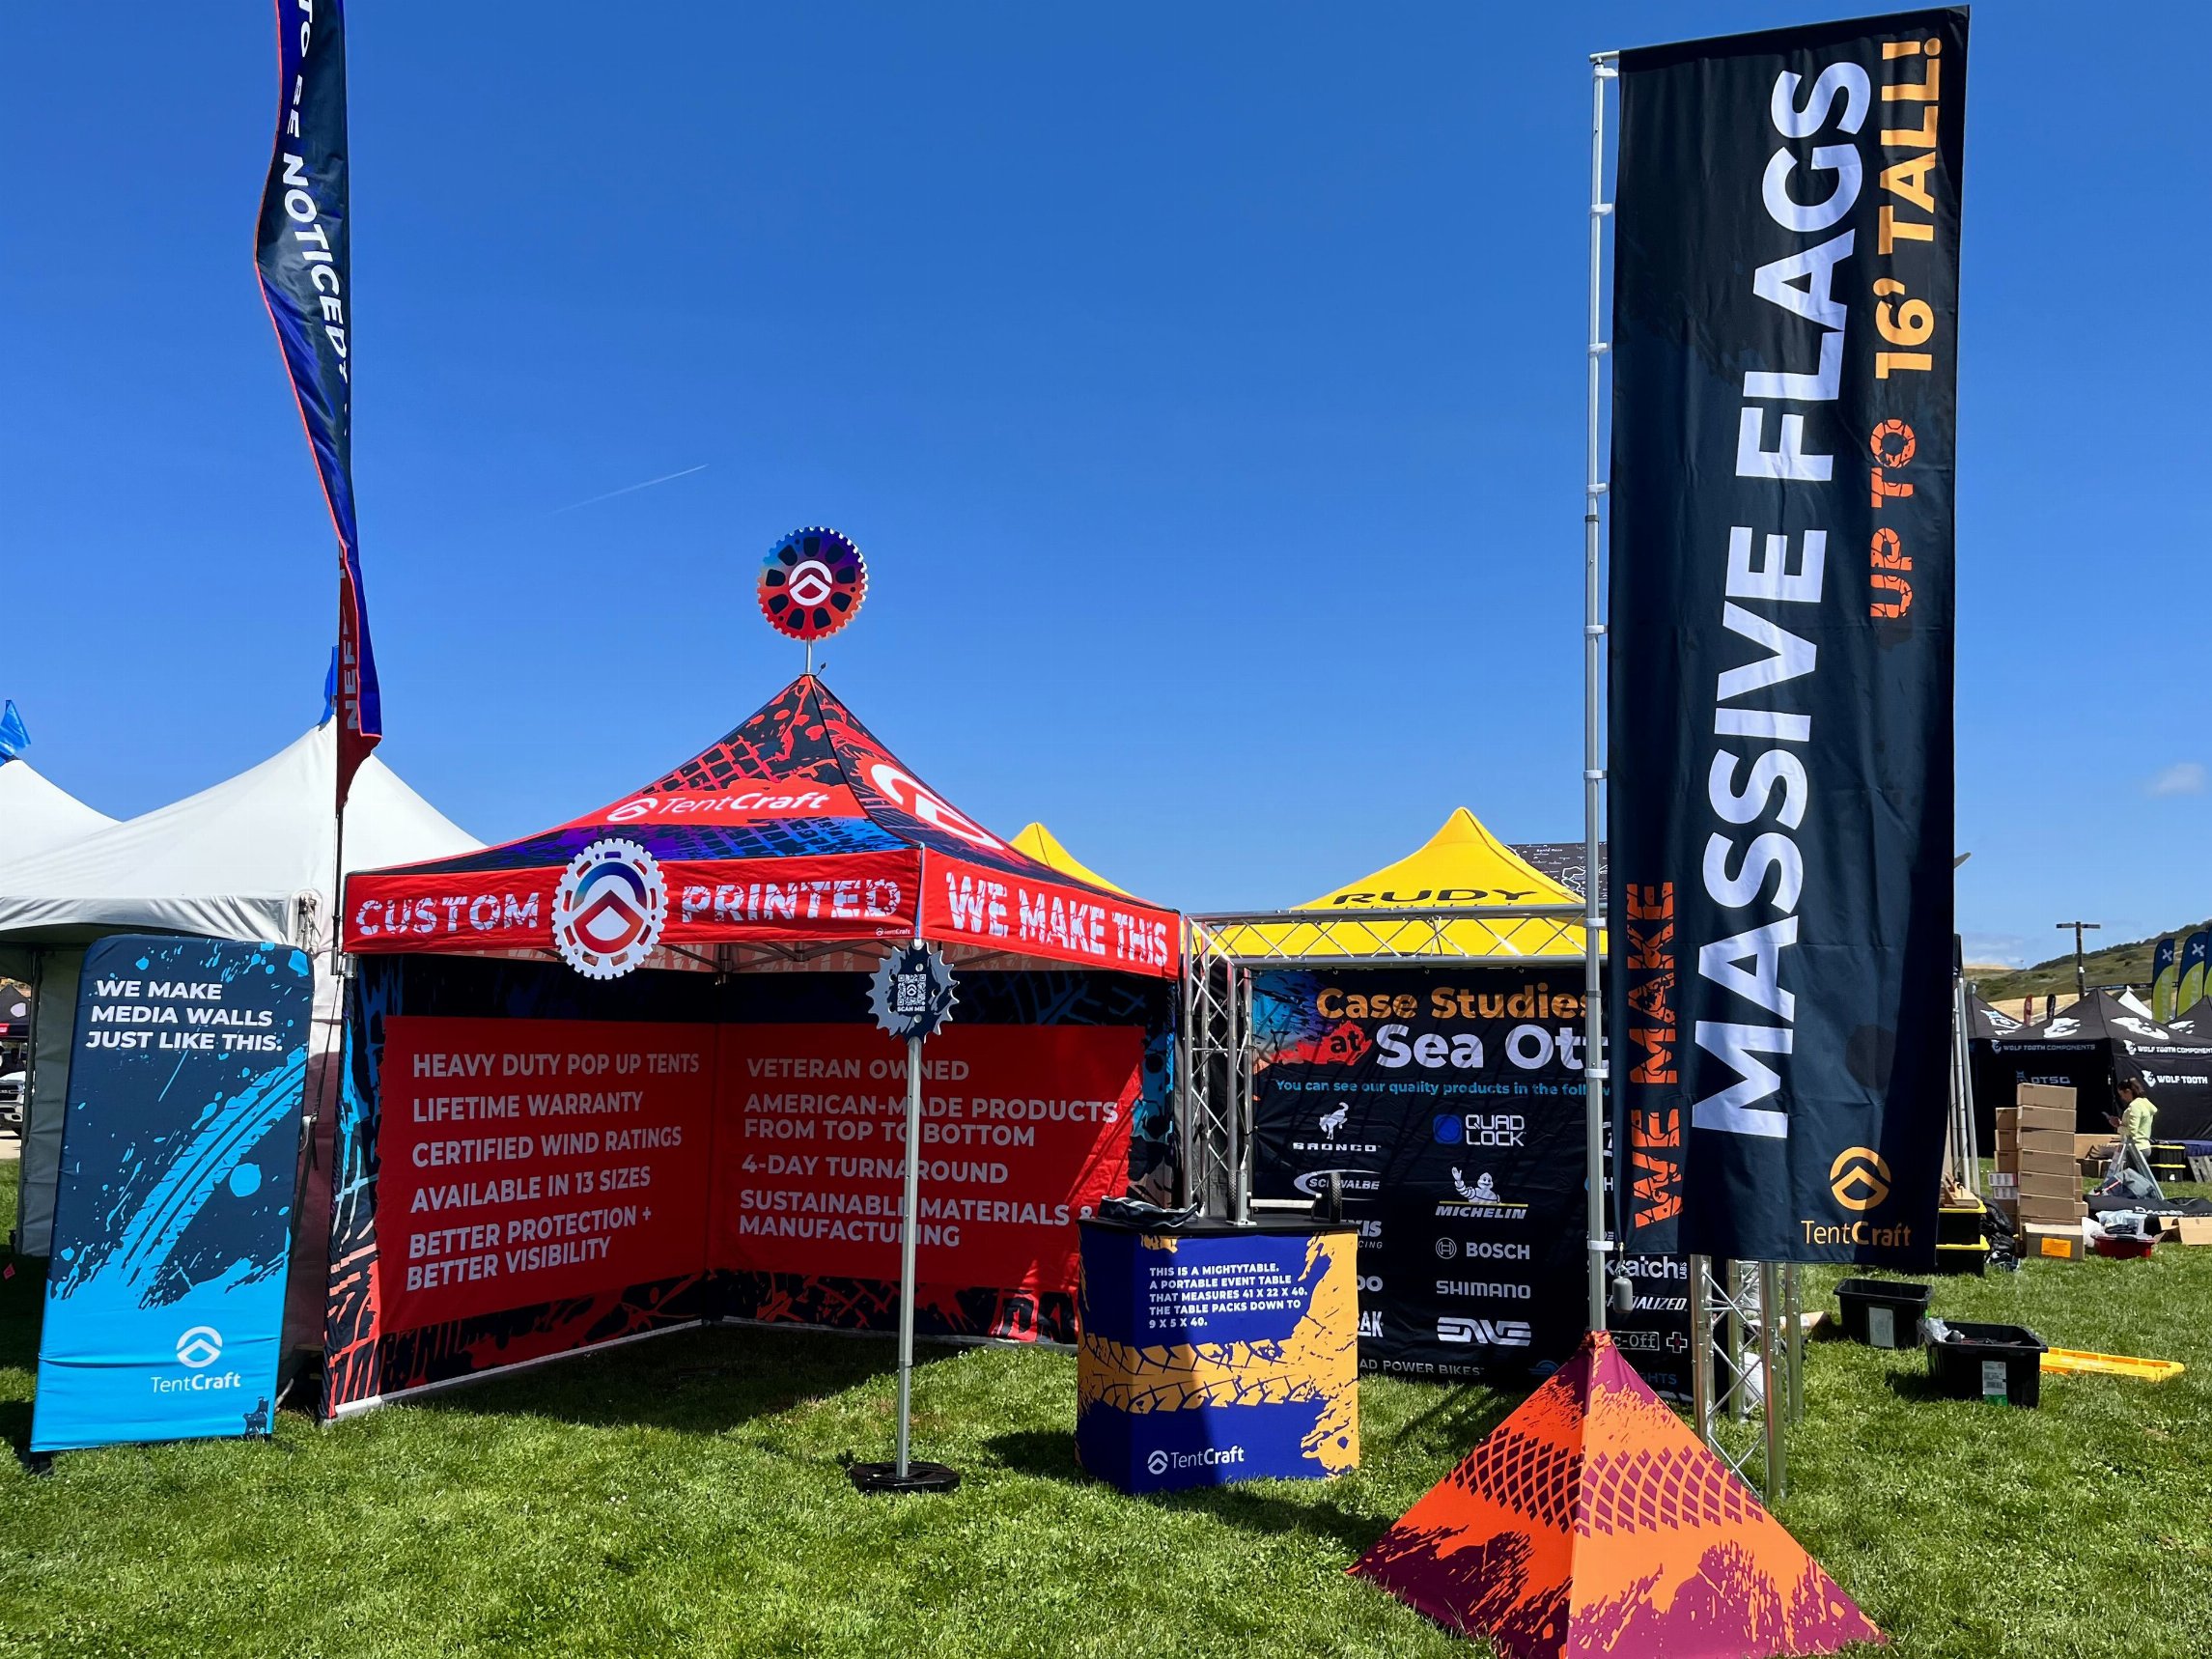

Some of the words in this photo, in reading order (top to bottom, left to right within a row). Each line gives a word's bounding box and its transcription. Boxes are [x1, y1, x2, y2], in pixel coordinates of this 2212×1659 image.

[287, 74, 303, 138] BE
[1878, 36, 1943, 255] TALL!
[1736, 60, 1872, 482] FLAGS
[1869, 418, 1916, 508] TO
[1869, 526, 1914, 619] UP
[658, 792, 830, 814] TentCraft
[1692, 525, 1829, 1139] MASSIVE
[355, 892, 540, 936] CUSTOM
[682, 878, 901, 922] PRINTED
[1333, 889, 1537, 905] RUDY
[946, 871, 1009, 938] WE
[1019, 888, 1106, 956] MAKE
[1112, 911, 1168, 967] THIS
[97, 979, 141, 998] WE
[148, 981, 223, 999] MAKE
[1626, 881, 1678, 1084] MAKE
[1316, 988, 1418, 1020] Case
[91, 1005, 178, 1024] MEDIA
[186, 1007, 273, 1026] WALLS
[86, 1030, 154, 1048] JUST
[159, 1032, 215, 1050] LIKE
[222, 1033, 283, 1052] THIS.
[1330, 1029, 1361, 1054] at
[1376, 1024, 1484, 1069] Sea
[2156, 1045, 2175, 1054] TOOTH
[413, 1054, 495, 1078] HEAVY
[502, 1054, 561, 1077] DUTY
[567, 1054, 610, 1075] POP
[615, 1054, 642, 1074] UP
[646, 1053, 700, 1073] TENTS
[746, 1058, 860, 1079] VETERAN
[1276, 1080, 1302, 1091] You
[1305, 1083, 1330, 1091] can
[1333, 1083, 1358, 1092] see
[1361, 1083, 1386, 1092] our
[1389, 1082, 1440, 1095] quality
[1443, 1082, 1509, 1095] products
[1514, 1082, 1527, 1094] in
[1532, 1083, 1557, 1095] the
[2157, 1075, 2179, 1083] WOLF
[2180, 1076, 2207, 1084] TOOTH
[413, 1095, 520, 1123] LIFETIME
[527, 1091, 644, 1116] WARRANTY
[971, 1098, 1118, 1124] PRODUCTS
[743, 1119, 815, 1139] FROM
[823, 1121, 873, 1141] TOP
[923, 1124, 1035, 1147] BOTTOM
[1466, 1114, 1525, 1130] QUAD
[412, 1136, 534, 1167] CERTIFIED
[541, 1132, 600, 1157] WIND
[605, 1126, 682, 1152] RATINGS
[1293, 1142, 1376, 1152] BRONCO
[1466, 1130, 1525, 1146] LOCK
[742, 1154, 818, 1175] 4-DAY
[1628, 1108, 1684, 1230] WE
[409, 1176, 542, 1214] AVAILABLE
[547, 1173, 570, 1196] IN
[575, 1171, 594, 1194] 13
[600, 1166, 651, 1191] SIZES
[1309, 1178, 1380, 1191] SCWALBE
[740, 1190, 906, 1217] SUSTAINABL
[920, 1198, 1070, 1226] MATERIALS
[1436, 1206, 1526, 1220] MICHELIN
[408, 1223, 500, 1259] BETTER
[507, 1205, 637, 1244] PROTECTION
[739, 1216, 960, 1247] MANUFACTUING
[1800, 1220, 1911, 1247] TentCraft
[1466, 1242, 1530, 1259] BOSCH
[406, 1253, 498, 1291] BETTER
[505, 1236, 611, 1274] VISIBILITY
[1149, 1267, 1174, 1277] THIS
[1178, 1266, 1188, 1276] IS
[1190, 1266, 1199, 1276] A
[1202, 1263, 1279, 1276] MIGHTYTABLE.
[1149, 1280, 1158, 1290] A
[1161, 1279, 1218, 1289] PORTABLE
[1221, 1276, 1255, 1287] EVENT
[1258, 1275, 1291, 1285] TABLE
[1436, 1280, 1531, 1299] SHIMANO
[1149, 1293, 1178, 1303] THAT
[1182, 1289, 1240, 1302] MEASURES
[1243, 1289, 1253, 1299] 41
[1256, 1289, 1264, 1298] X
[1267, 1288, 1278, 1297] 22
[1281, 1287, 1288, 1297] X
[1292, 1287, 1307, 1296] 40.
[1149, 1307, 1170, 1316] THE
[1174, 1304, 1208, 1314] TABLE
[1212, 1302, 1246, 1312] PACKS
[1250, 1300, 1284, 1311] DOWN
[1287, 1299, 1301, 1308] TO
[1149, 1319, 1156, 1329] 9
[1160, 1319, 1166, 1328] X
[1170, 1318, 1176, 1328] 5
[1180, 1318, 1187, 1327] X
[1190, 1316, 1207, 1326] 40.
[1359, 1359, 1378, 1369] AD
[1384, 1361, 1434, 1374] POWER
[1440, 1364, 1480, 1376] BIKES
[151, 1371, 241, 1393] TentCraft
[1170, 1446, 1244, 1469] TentCraft
